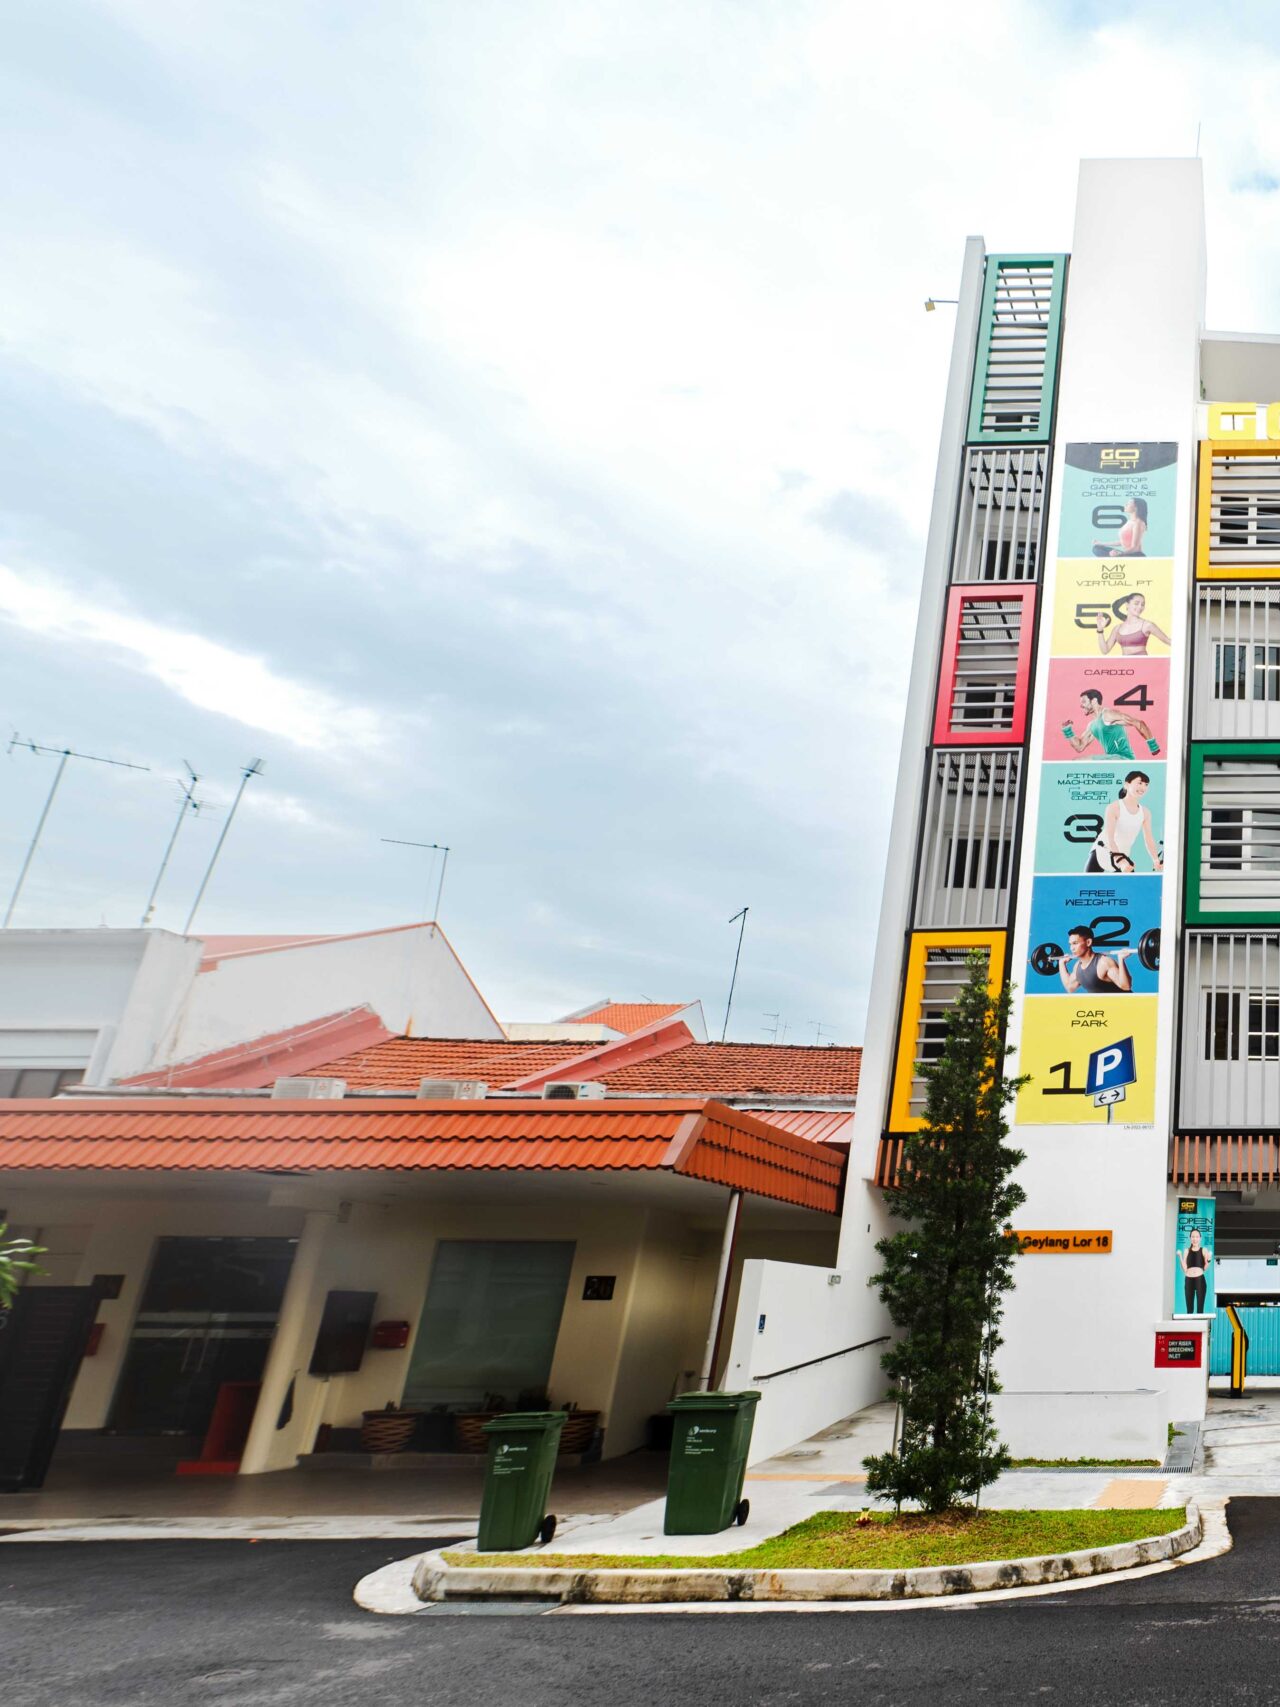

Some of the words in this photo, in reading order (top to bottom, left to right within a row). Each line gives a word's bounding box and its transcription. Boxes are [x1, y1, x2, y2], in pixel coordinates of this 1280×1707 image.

[1101, 449, 1140, 460] GO
[1100, 460, 1140, 469] FIT
[1092, 505, 1128, 529] 6
[1101, 564, 1126, 572] MY
[1074, 603, 1112, 629] 5
[1113, 684, 1154, 711] 4
[1063, 814, 1104, 843] 3
[1079, 889, 1116, 897] FREE
[1065, 898, 1129, 906] WEIGHTS
[1089, 915, 1132, 947] 2
[1076, 1010, 1105, 1018] CAR
[1071, 1019, 1108, 1028] PARK
[1095, 1048, 1123, 1087] P
[1042, 1061, 1087, 1095] 1
[1179, 1217, 1213, 1225] OPEN
[1023, 1236, 1070, 1250] Geylang
[1073, 1236, 1092, 1247] Lor
[1096, 1236, 1109, 1247] 18
